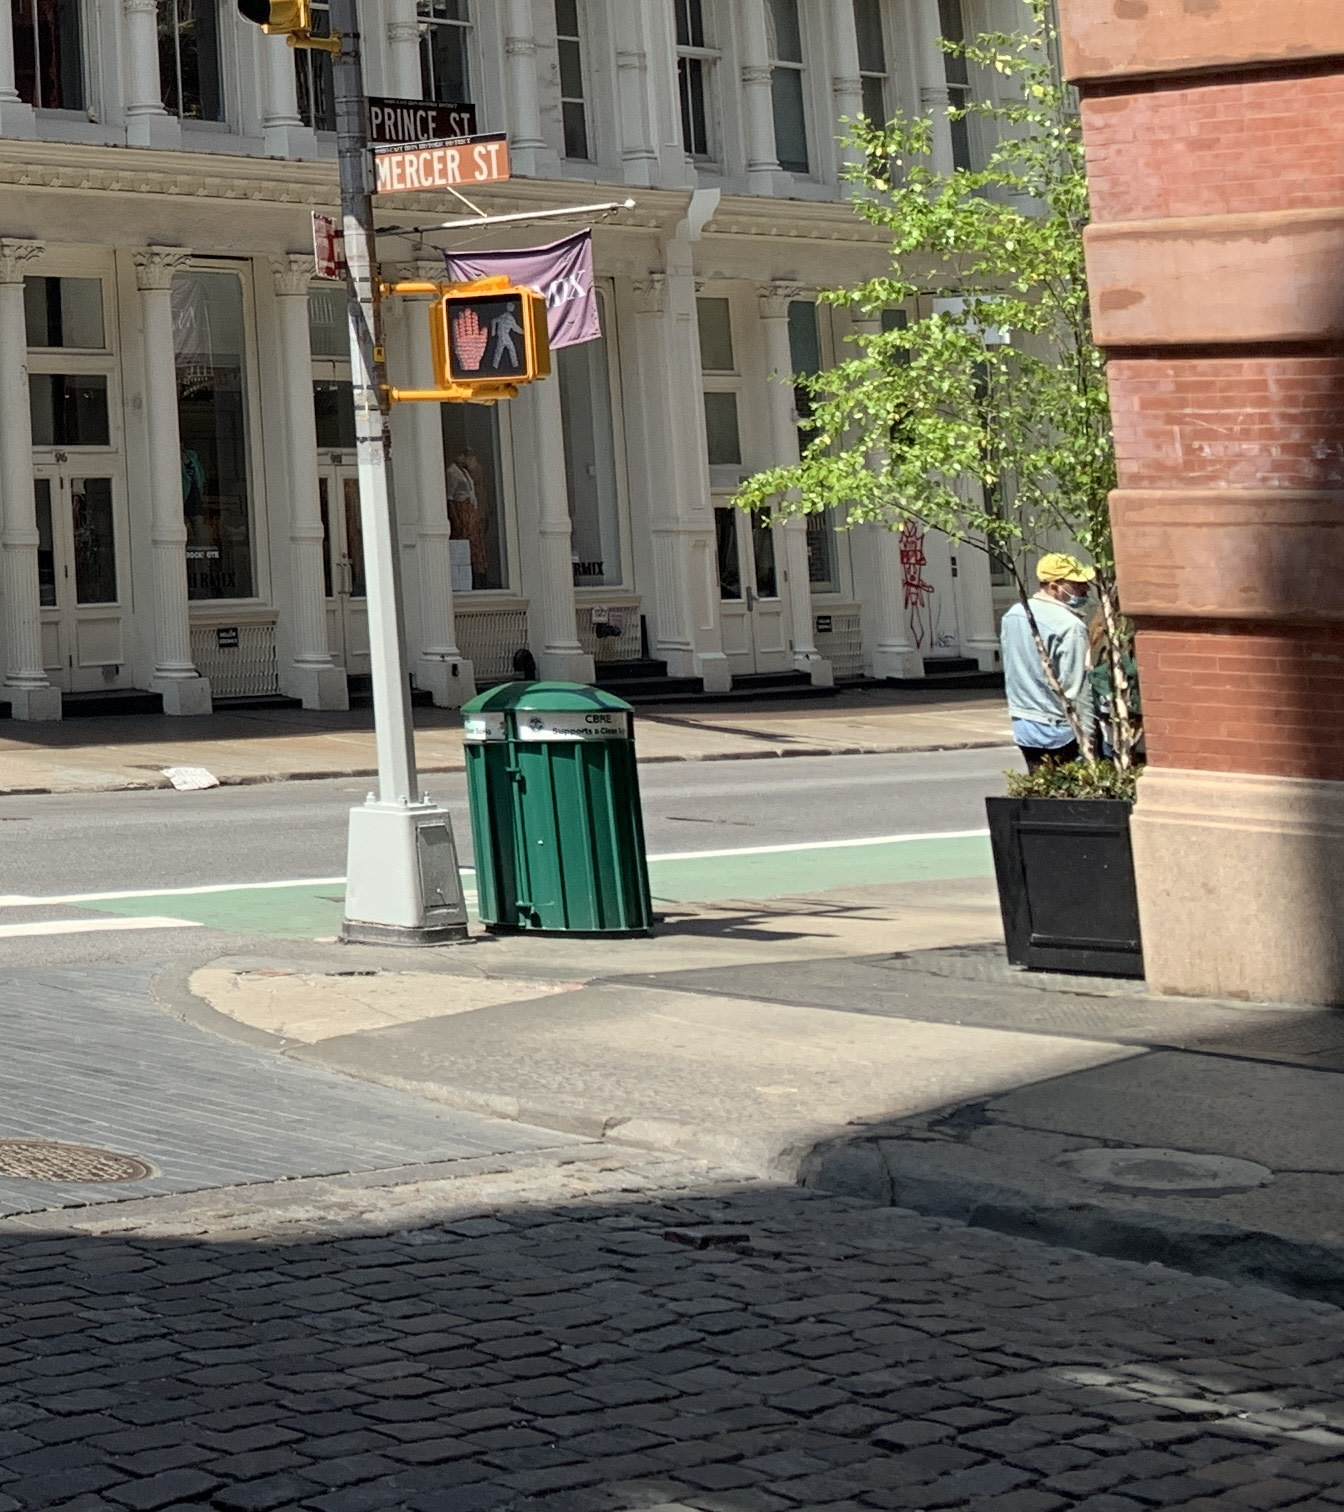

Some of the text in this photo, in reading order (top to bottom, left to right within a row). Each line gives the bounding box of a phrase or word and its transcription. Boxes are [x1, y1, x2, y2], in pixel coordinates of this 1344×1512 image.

[370, 105, 471, 141] PRINCE ST
[375, 144, 500, 192] MERCER ST
[584, 714, 612, 724] CBRE
